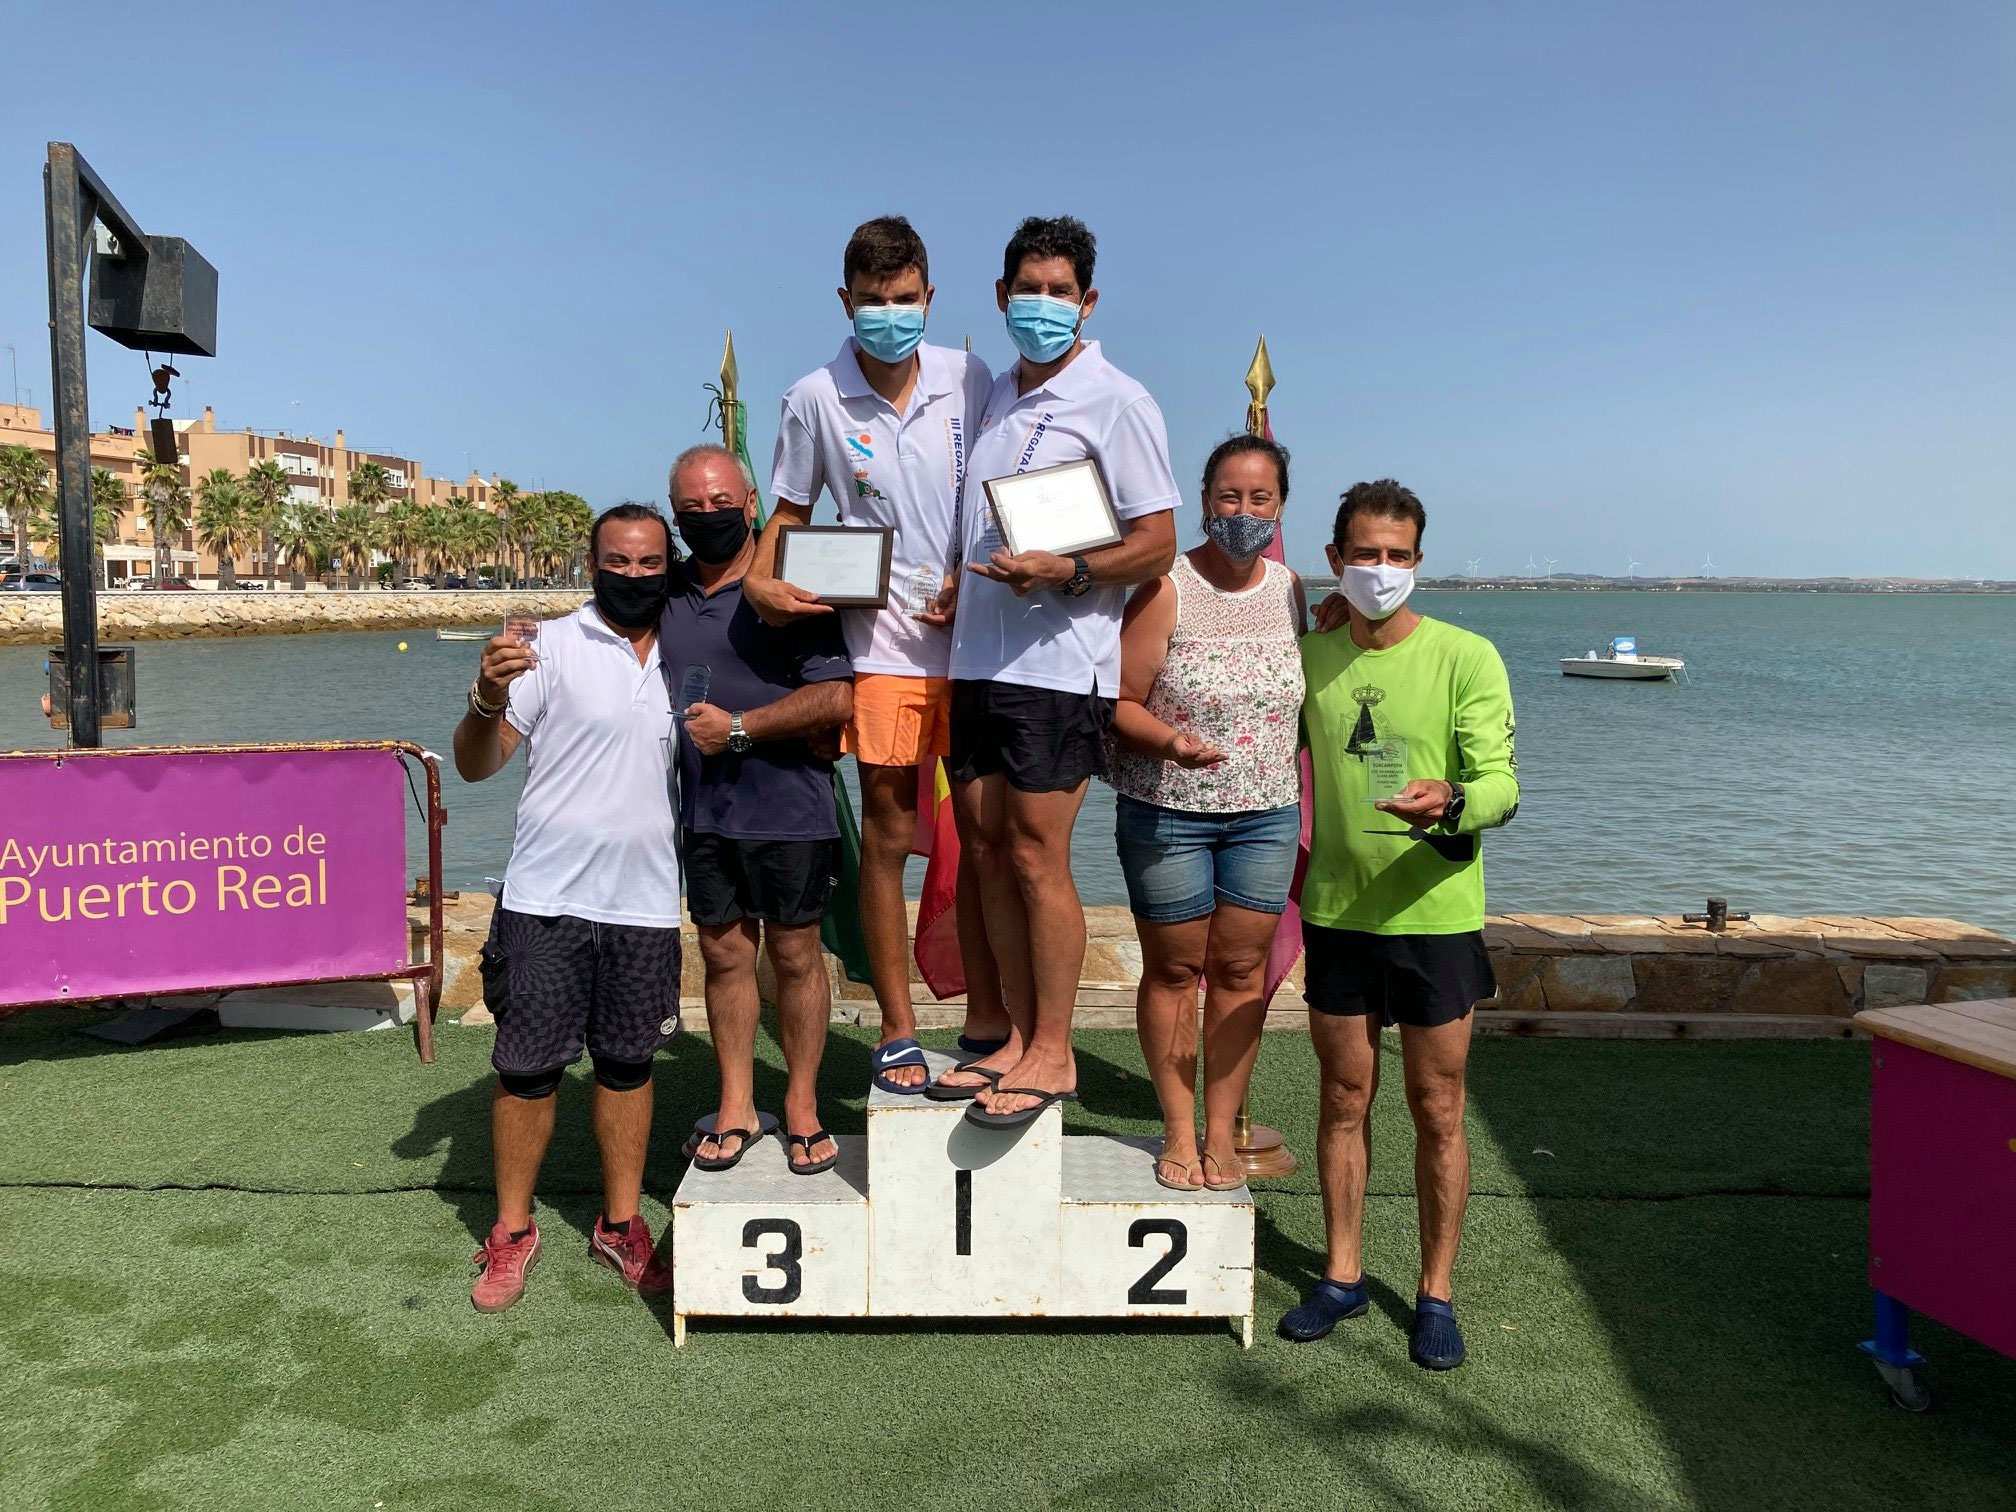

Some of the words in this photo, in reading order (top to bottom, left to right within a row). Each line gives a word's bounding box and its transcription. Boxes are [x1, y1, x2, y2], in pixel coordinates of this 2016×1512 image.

[950, 417, 961, 430] III
[1020, 422, 1046, 466] REGATA
[952, 432, 963, 483] REGATA
[0, 831, 272, 877] Ayuntamiento
[283, 824, 326, 856] de
[0, 875, 197, 925] Puerto
[217, 858, 327, 911] Real
[955, 1169, 972, 1256] 1
[742, 1218, 802, 1304] 3
[1127, 1218, 1188, 1305] 2
